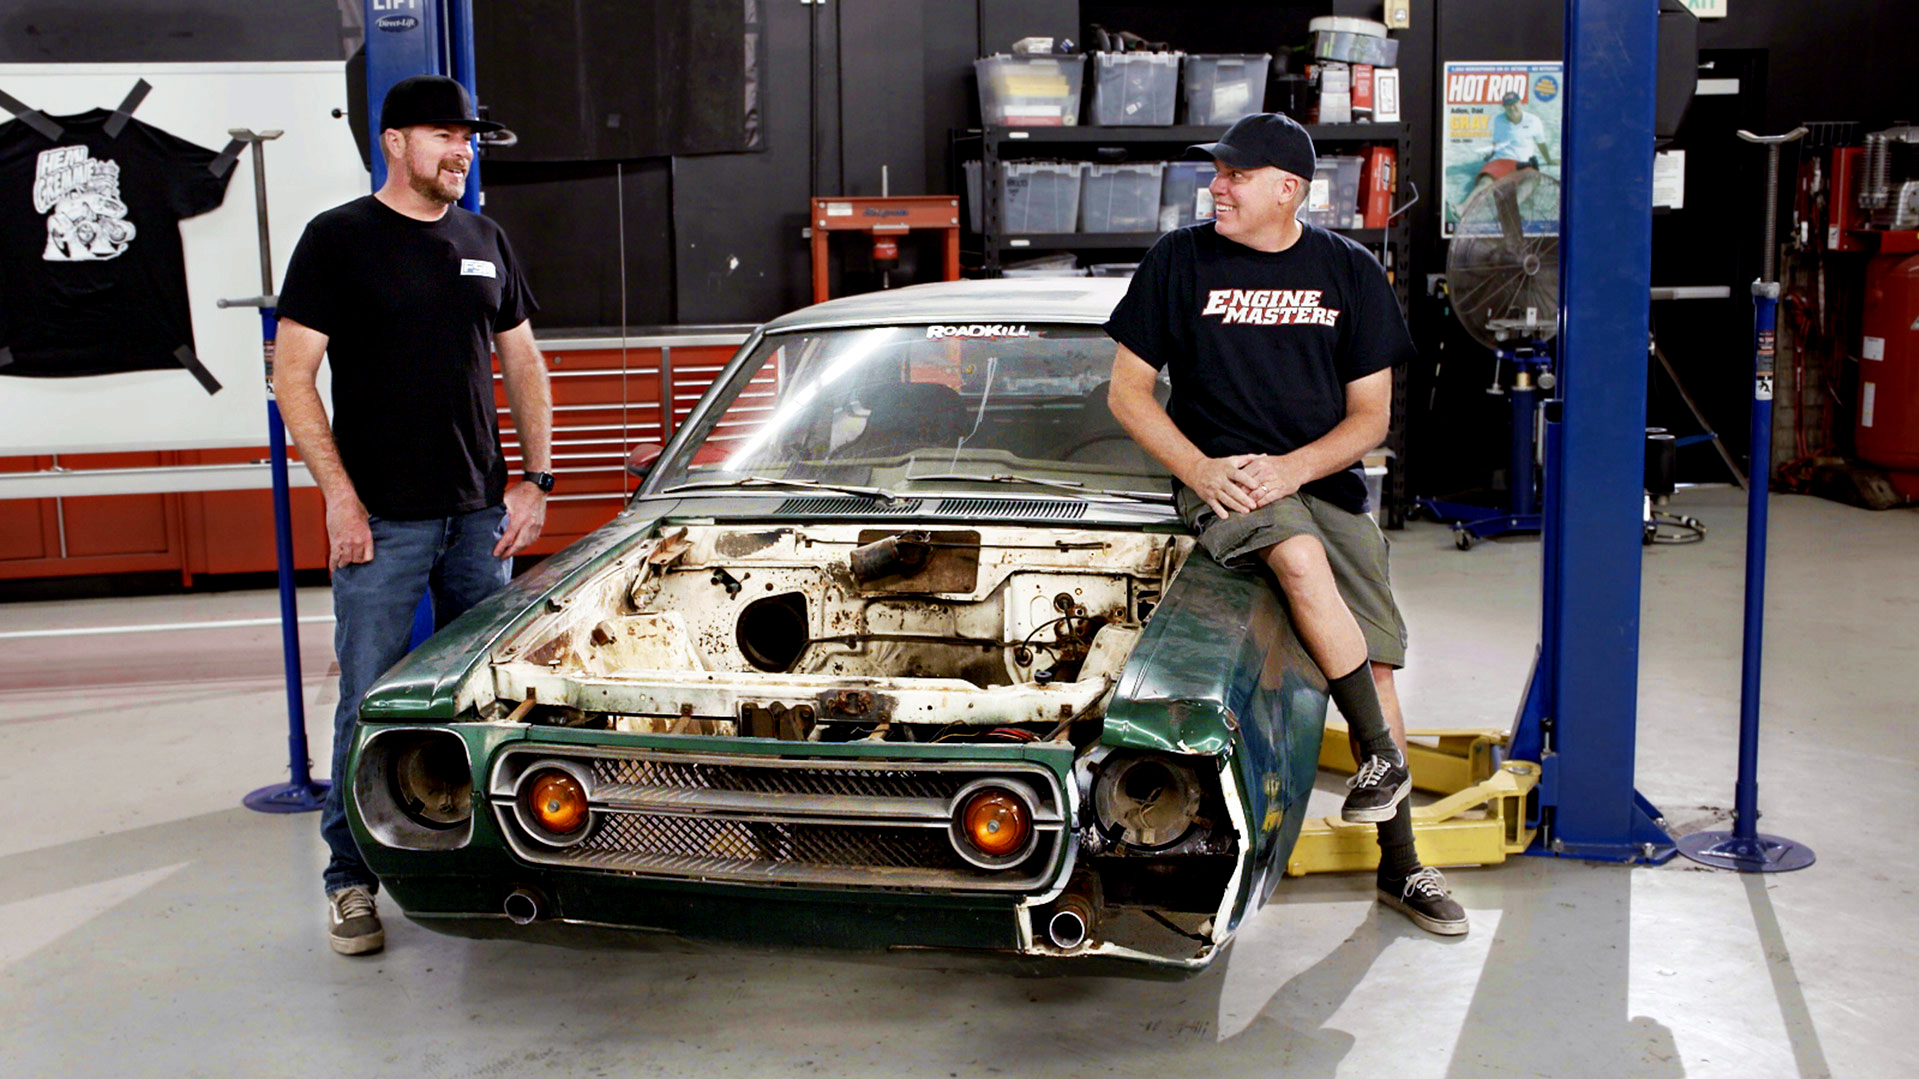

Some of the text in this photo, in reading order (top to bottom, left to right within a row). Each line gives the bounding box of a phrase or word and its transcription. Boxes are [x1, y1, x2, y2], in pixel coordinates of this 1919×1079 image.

[1448, 74, 1488, 102] HOT
[1450, 114, 1491, 130] GRAY
[1202, 289, 1322, 315] ENGINE
[1222, 306, 1340, 327] MASTERS
[926, 324, 1030, 339] ROADKILL
